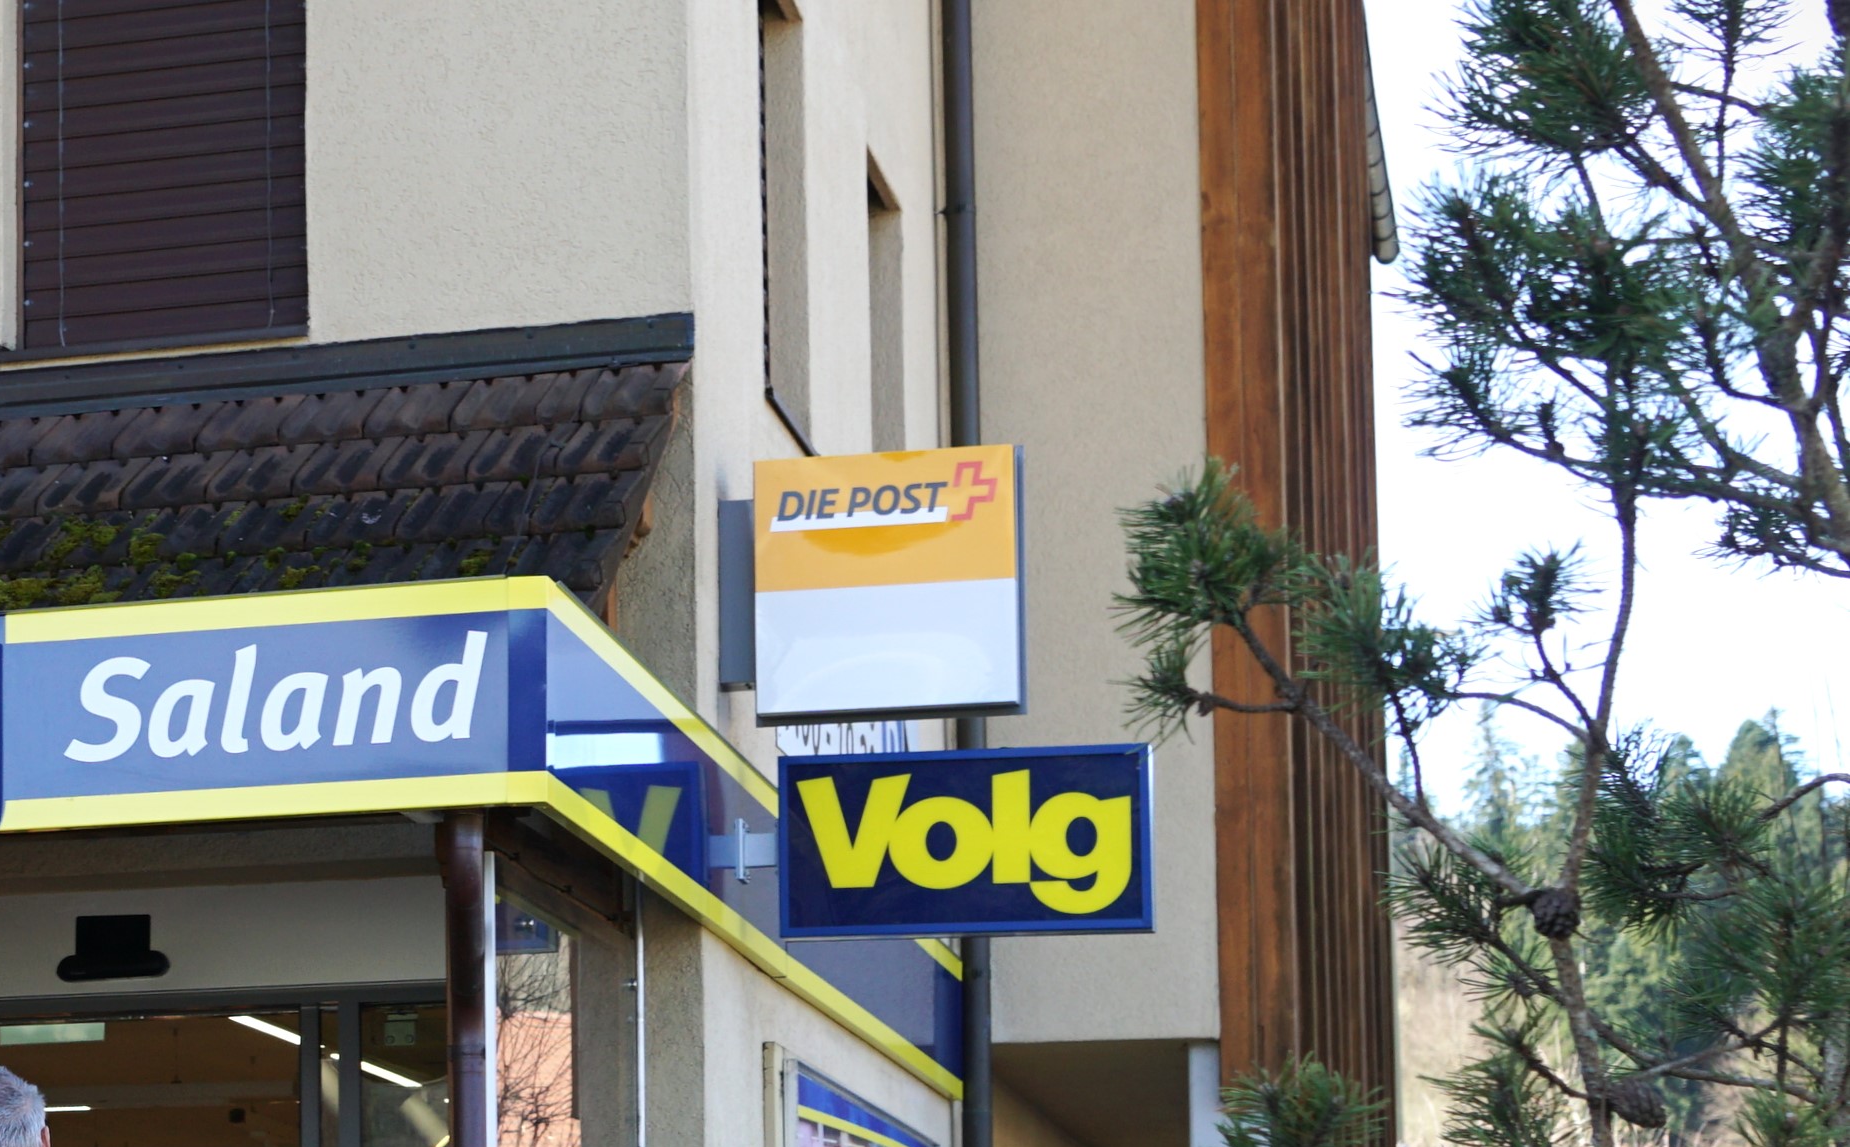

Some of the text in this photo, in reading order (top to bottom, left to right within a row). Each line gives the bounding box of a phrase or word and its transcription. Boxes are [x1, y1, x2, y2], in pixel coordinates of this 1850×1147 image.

[776, 481, 948, 522] DIE POST
[63, 629, 488, 763] Saland
[796, 768, 1132, 915] Volg
